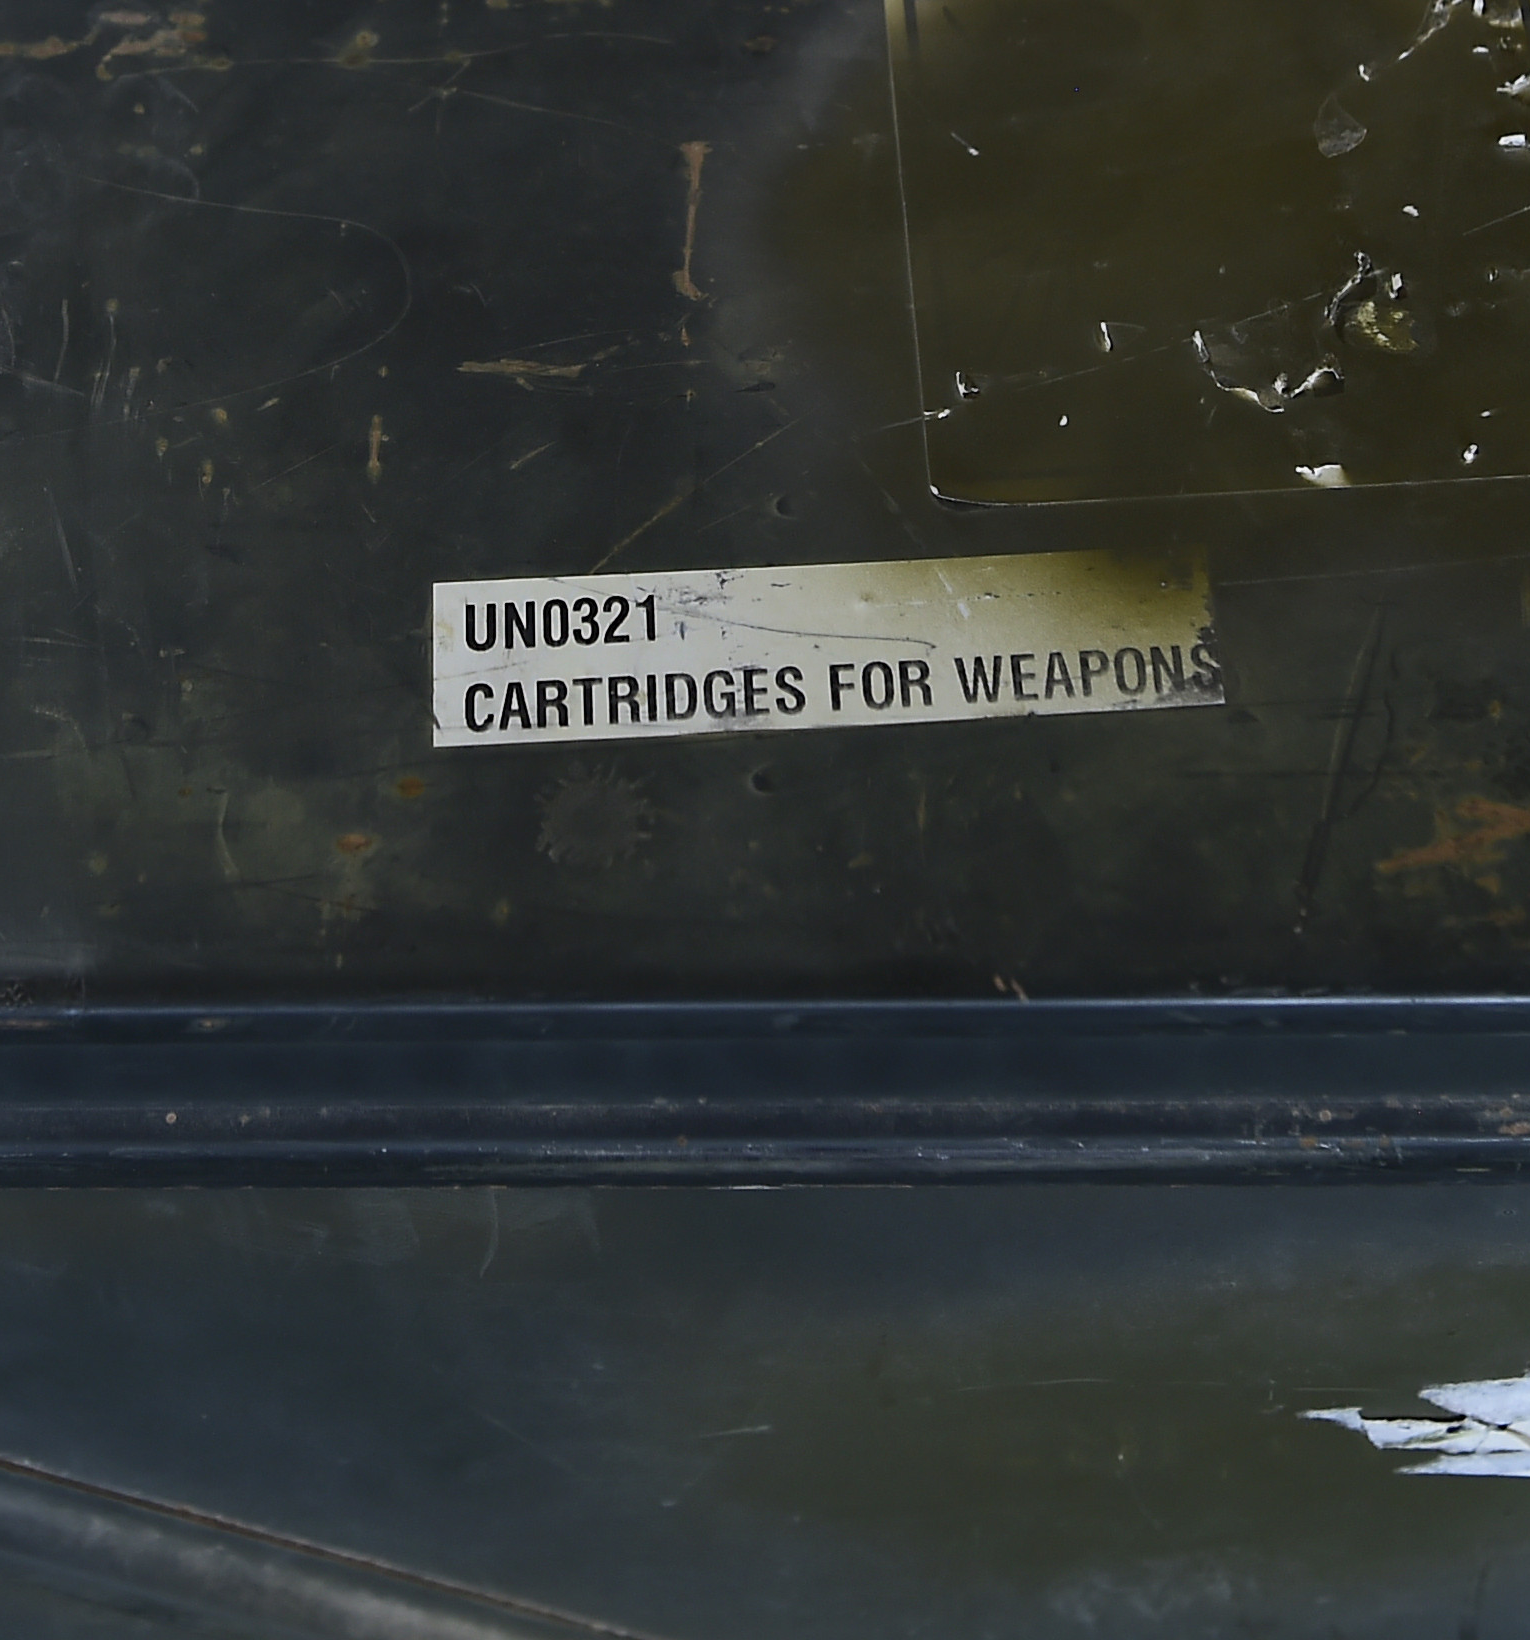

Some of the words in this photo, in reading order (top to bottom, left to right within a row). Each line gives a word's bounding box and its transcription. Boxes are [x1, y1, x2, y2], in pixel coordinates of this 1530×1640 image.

[463, 593, 660, 652] UN0321
[462, 665, 808, 733] CARTRIDGES
[829, 659, 935, 713] FOR
[954, 641, 1223, 705] WEAPONS
